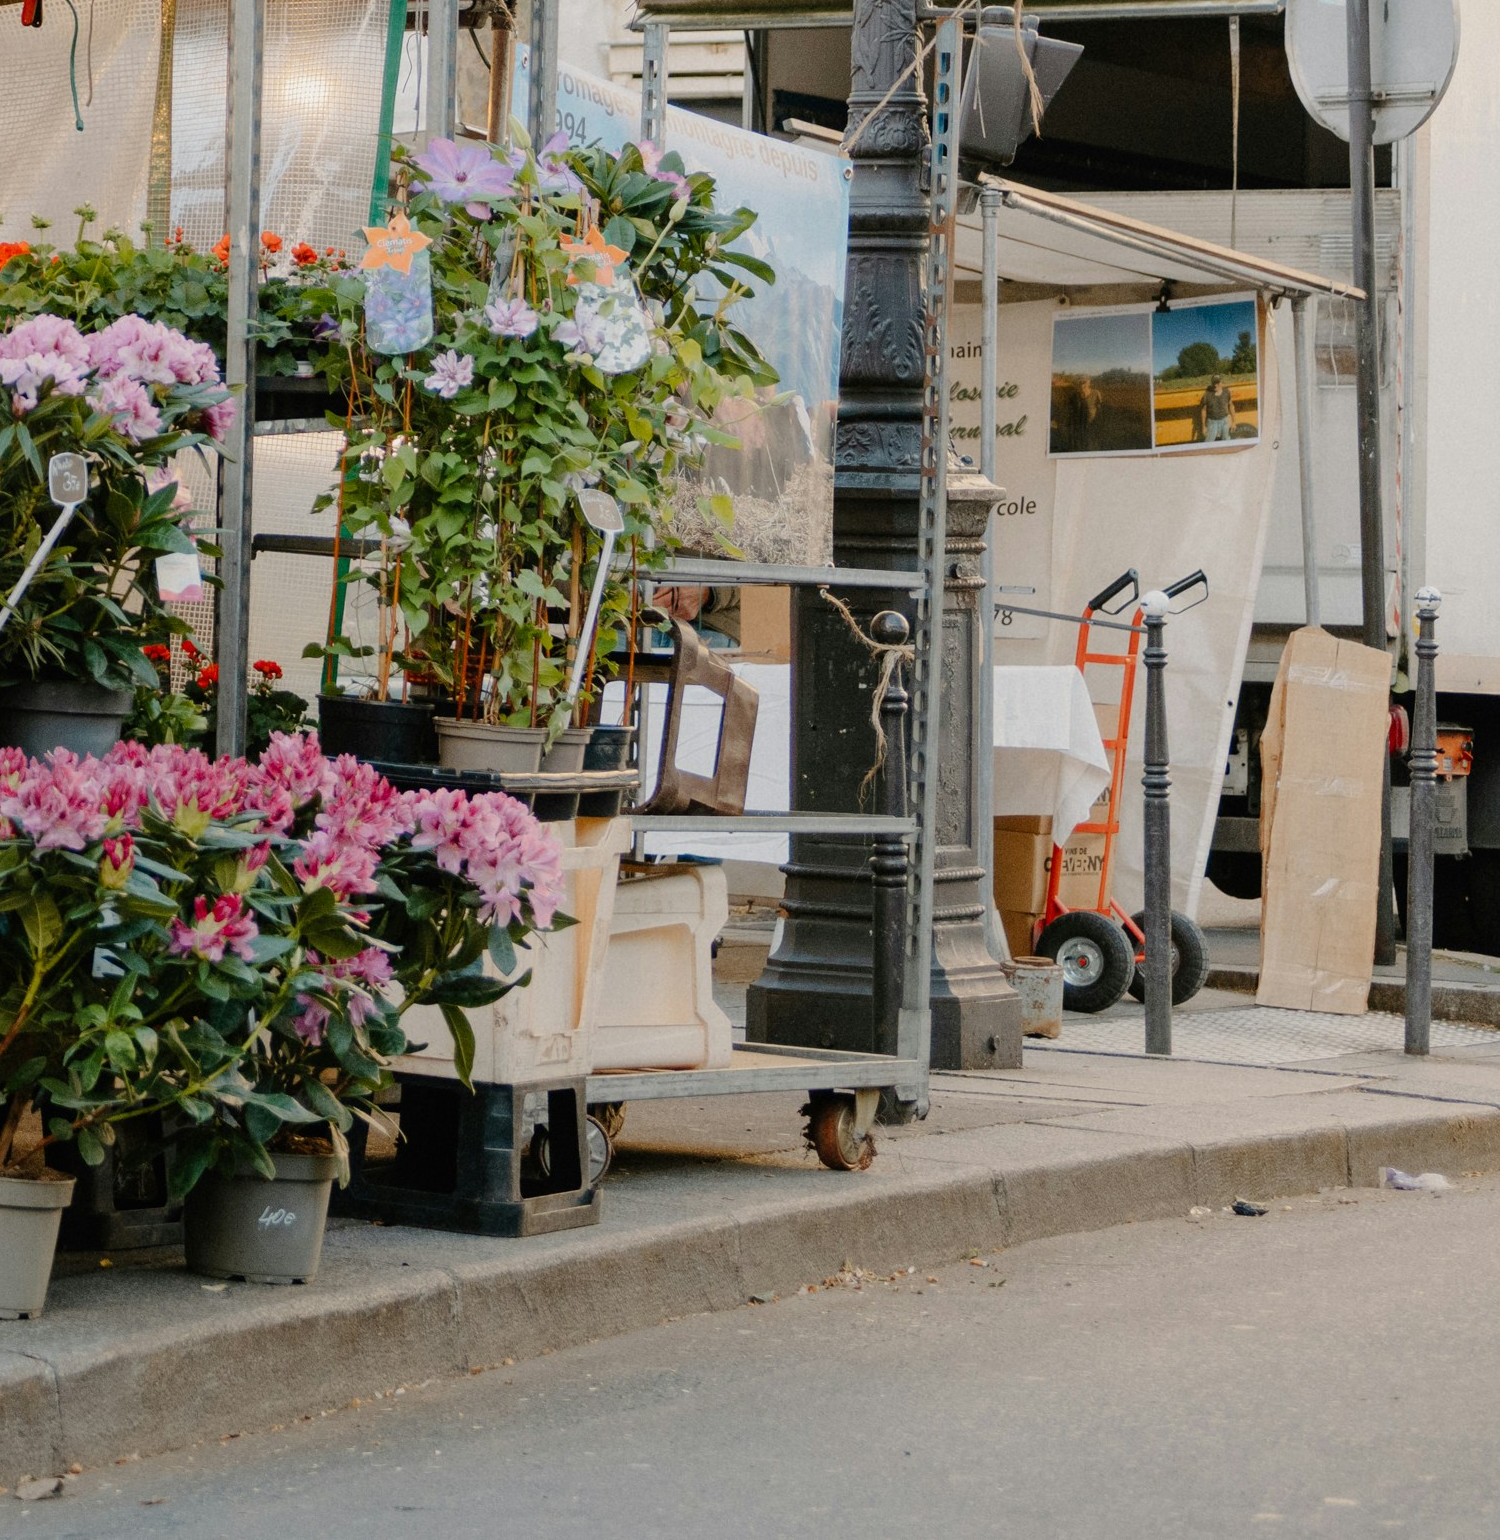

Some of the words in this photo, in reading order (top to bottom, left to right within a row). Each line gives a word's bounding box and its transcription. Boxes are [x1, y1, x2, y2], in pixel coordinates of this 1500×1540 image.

[556, 108, 587, 144] 994
[556, 71, 636, 117] romages
[758, 140, 819, 182] depuis
[996, 496, 1037, 516] cole
